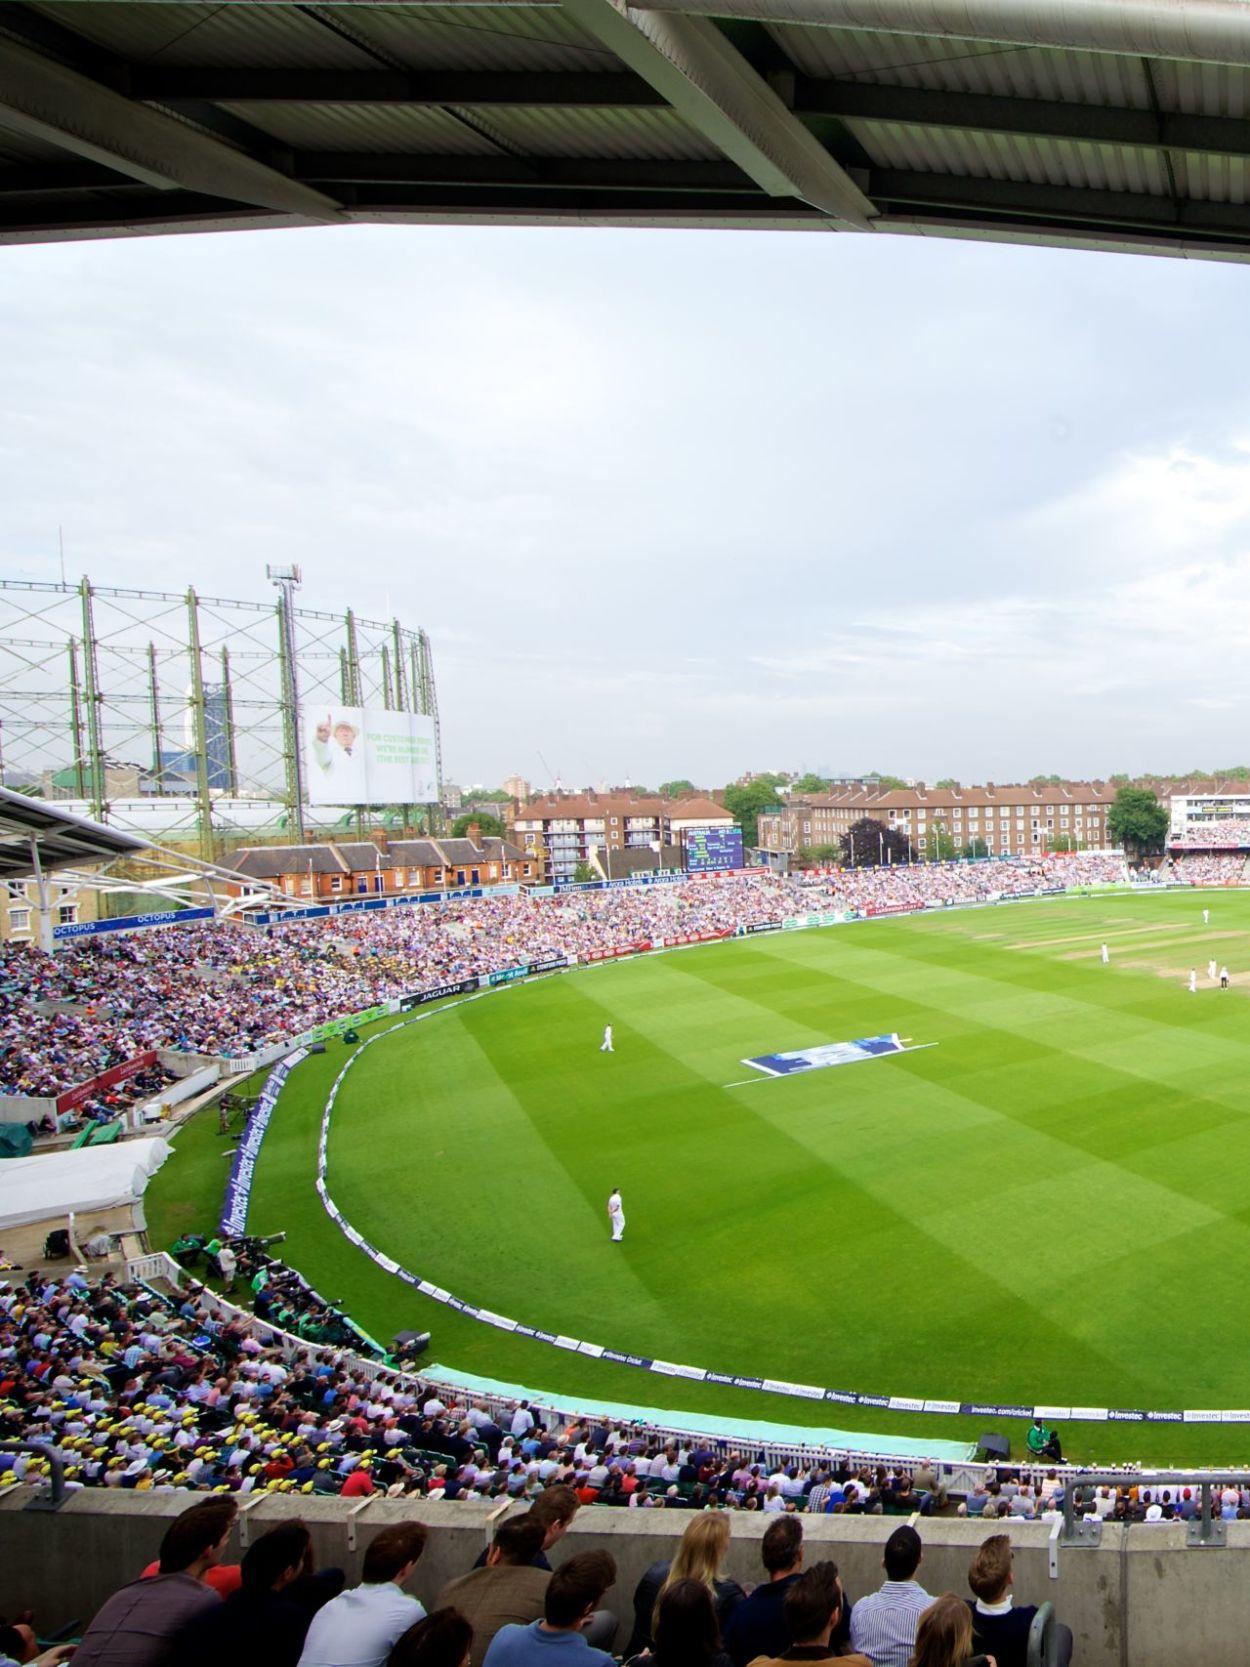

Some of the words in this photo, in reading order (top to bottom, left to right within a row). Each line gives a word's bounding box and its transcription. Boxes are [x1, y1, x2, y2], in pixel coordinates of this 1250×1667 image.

[137, 913, 176, 923] OCTOPUS
[54, 923, 96, 935] OCTOPUS
[421, 985, 460, 1001] JAGUAR
[1114, 1411, 1143, 1421] Investec
[1153, 1411, 1183, 1420] Investec
